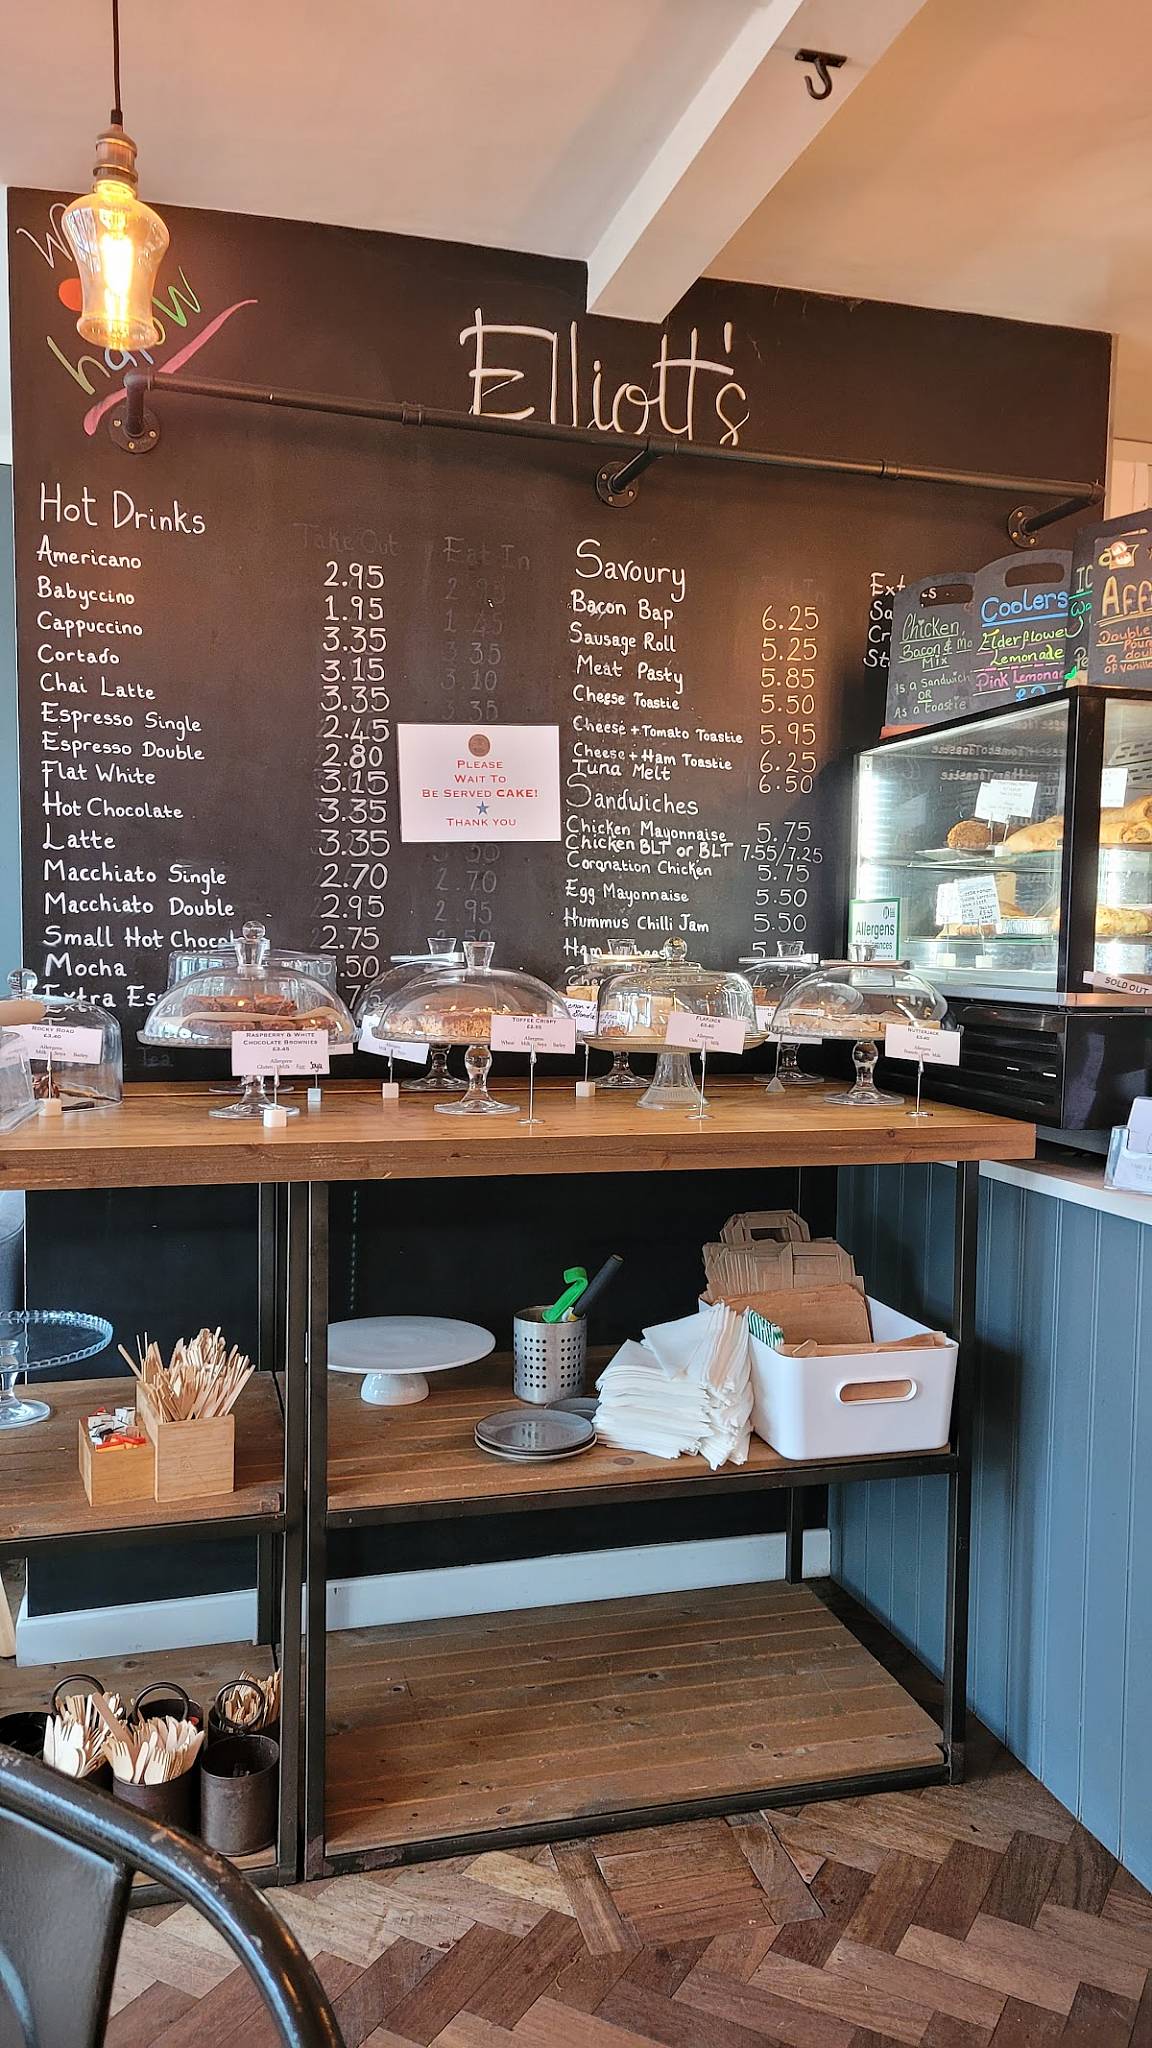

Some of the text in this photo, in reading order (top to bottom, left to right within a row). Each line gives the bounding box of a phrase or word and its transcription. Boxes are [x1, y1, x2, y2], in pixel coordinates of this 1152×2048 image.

[459, 307, 750, 446] Elliott's
[40, 482, 206, 535] Hot Drinks
[37, 534, 143, 570] Americano
[323, 561, 385, 591] 2.95
[575, 538, 687, 603] Savoury
[37, 575, 136, 611] Babyccino
[981, 588, 1069, 623] Coolers
[324, 595, 385, 622] 1.95
[570, 588, 674, 630] Bacon Bap
[762, 605, 820, 632] 6.25
[37, 610, 143, 638] Cappuccino
[1098, 625, 1151, 645] Double
[322, 626, 387, 654] 3.35
[569, 621, 677, 656] Sausage Roll
[761, 637, 819, 663] 5.25
[902, 643, 941, 661] Bacon
[37, 643, 120, 665] Cortado
[922, 654, 948, 669] Mix
[989, 643, 1065, 668] Lemonade
[1106, 654, 1117, 664] a
[320, 657, 385, 683] 3.15
[576, 654, 684, 695] Meat Pasty
[761, 668, 816, 690] 5.85
[920, 671, 970, 689] Sandwich
[975, 671, 1009, 692] Pink
[1104, 663, 1118, 674] of
[40, 671, 156, 701] Chai Latte
[320, 685, 391, 713] 3.35
[572, 684, 681, 711] Cheese Toastie
[918, 689, 932, 700] OR
[760, 694, 816, 716] 5.50
[894, 697, 967, 719] As a toastie
[41, 701, 203, 742] Espresso Single
[322, 714, 391, 744] 2.45
[572, 715, 627, 736] Cheese
[642, 724, 690, 741] Tomato
[695, 728, 744, 745] Toastie
[760, 722, 817, 747] 5.95
[41, 730, 205, 761] Espresso Double
[321, 743, 384, 769] 2.80
[573, 742, 626, 762] Cheese
[640, 749, 677, 767] Ham
[681, 753, 733, 771] Toastie
[41, 760, 157, 788] Flat White
[457, 760, 503, 769] PLEASE
[572, 758, 672, 781] Tuna Melt
[758, 750, 818, 775] 6.25
[319, 769, 390, 796] 3.15
[454, 774, 485, 783] WAIT
[758, 774, 813, 794] 6.50
[42, 790, 185, 820] Hot Chocolate
[422, 789, 538, 798] BE SERVED CAKE!
[565, 771, 700, 817] Sandwiches
[318, 797, 388, 825] 3.35
[447, 818, 517, 827] THANK YOU
[42, 822, 116, 851] Latte
[318, 828, 391, 858] 3.35
[566, 814, 728, 846] Chicken Mayonnaise
[757, 821, 812, 845] 5.75
[565, 834, 734, 859] Chicken BLT or BLT
[44, 859, 227, 895] Macchiato Single
[320, 863, 390, 890] 2.70
[567, 850, 713, 881] Coronation Chicken
[758, 864, 811, 884] 5.75
[44, 892, 235, 917] Macchiato Double
[565, 878, 690, 908] Egg Mayonnaise
[755, 888, 808, 908] 5.50
[320, 894, 386, 921] 2.95
[563, 906, 710, 933] Hummus Chilli Jam
[754, 913, 807, 933] 5.50
[855, 921, 895, 940] Allergens
[42, 924, 164, 950] Small Hot
[319, 925, 380, 951] 2.75
[45, 953, 128, 977] Mocha
[1104, 976, 1150, 996] SOLD OUT
